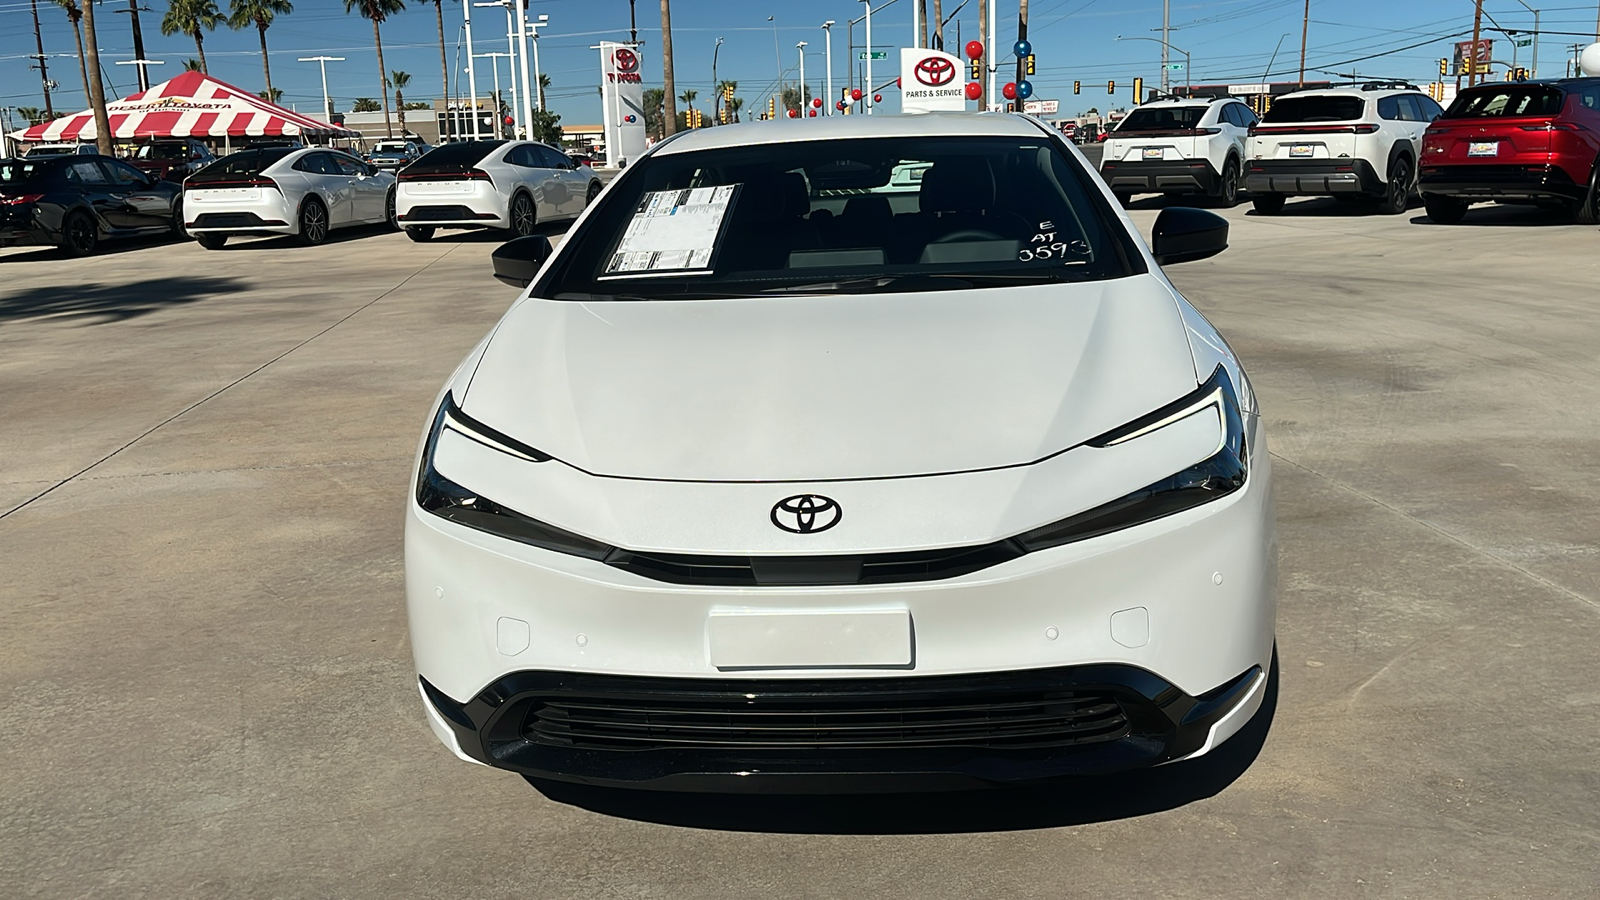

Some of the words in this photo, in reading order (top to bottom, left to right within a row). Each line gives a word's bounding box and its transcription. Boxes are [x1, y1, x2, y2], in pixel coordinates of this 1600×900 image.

[905, 90, 927, 98] PARTS
[928, 89, 934, 97] &
[935, 89, 962, 97] SERVICE
[108, 102, 163, 112] DESERT
[171, 102, 232, 110] TOYOTA
[1039, 220, 1055, 230] E
[1030, 231, 1057, 242] AT
